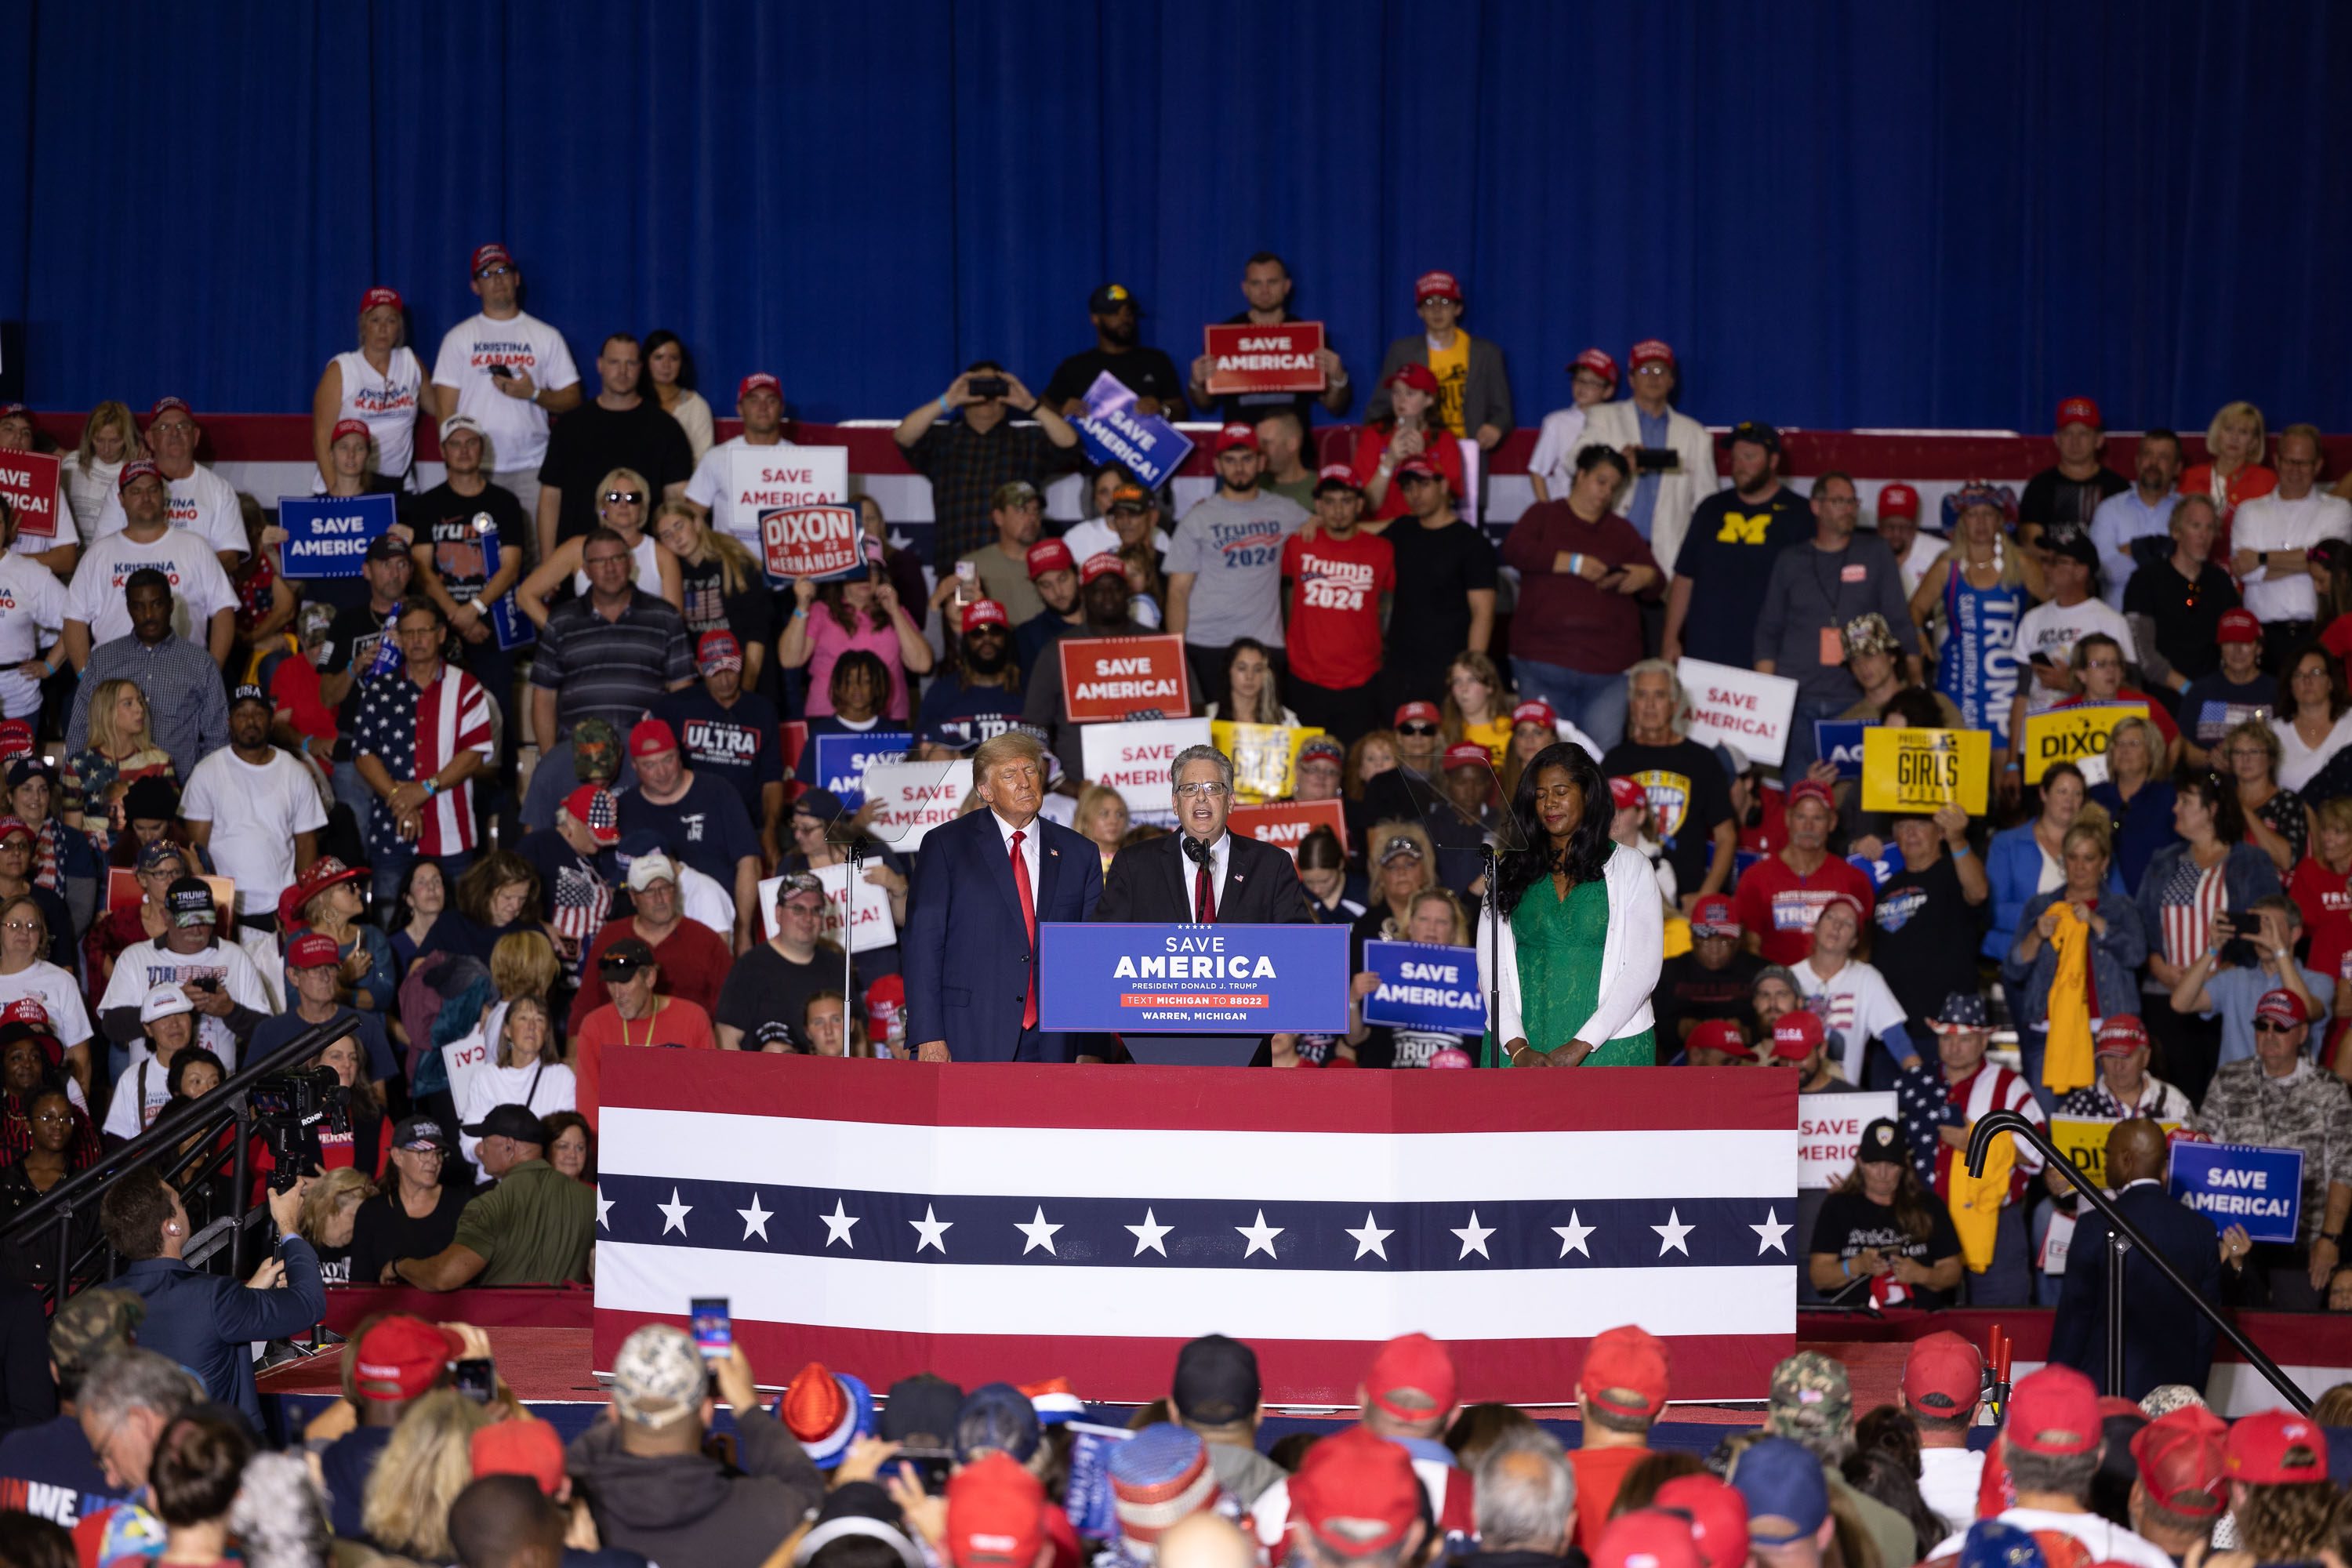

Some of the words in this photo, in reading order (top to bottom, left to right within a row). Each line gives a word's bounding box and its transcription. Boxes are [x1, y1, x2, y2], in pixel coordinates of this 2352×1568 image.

[474, 343, 532, 353] KRISTINA
[1237, 336, 1292, 350] SAVE
[1216, 353, 1316, 371] AMERICA!
[1109, 410, 1157, 452] SAVE
[1077, 415, 1160, 481] AMERICA!
[0, 470, 31, 488] AVE
[761, 469, 812, 483] SAVE
[8, 492, 49, 514] RICA!
[740, 491, 836, 506] AMERICA!
[311, 516, 364, 535] SAVE
[765, 511, 851, 545] DIXON
[1210, 520, 1280, 539] Trump
[1717, 512, 1772, 544] M
[290, 538, 369, 556] AMERIC
[770, 550, 854, 575] HERNANDEZ
[1225, 548, 1276, 568] 2024
[1301, 554, 1374, 582] Trump
[1303, 587, 1363, 611] 2024
[1095, 658, 1152, 677] SAVE
[1983, 596, 2020, 740] TRUMP
[1075, 678, 1178, 700] AMERICA!
[1707, 688, 1758, 712] SAVE
[1682, 705, 1777, 739] AMERICA!
[1962, 702, 1979, 731] AGAI
[688, 725, 755, 755] ULTRA
[2042, 732, 2109, 758] DIXO
[1123, 746, 1174, 761] SAVE
[1897, 753, 1958, 787] GIRLS
[902, 786, 956, 802] SAVE
[879, 808, 959, 827] AMERIC
[1254, 823, 1311, 843] SAVE
[176, 891, 207, 901] TRUMP
[1165, 936, 1225, 953] SAVE
[1113, 956, 1276, 978] AMERICA
[1400, 962, 1459, 985] SAVE
[1156, 996, 1210, 1005] MICHIGAN
[1374, 982, 1482, 1011] AMERICA!
[1142, 1011, 1191, 1022] WARREN,
[1194, 1012, 1247, 1021] MICHIGAN
[301, 1111, 323, 1127] RONIN
[1802, 1120, 1859, 1135] SAVE
[2207, 1167, 2267, 1191] SAVE
[2180, 1189, 2290, 1218] AMERICA!
